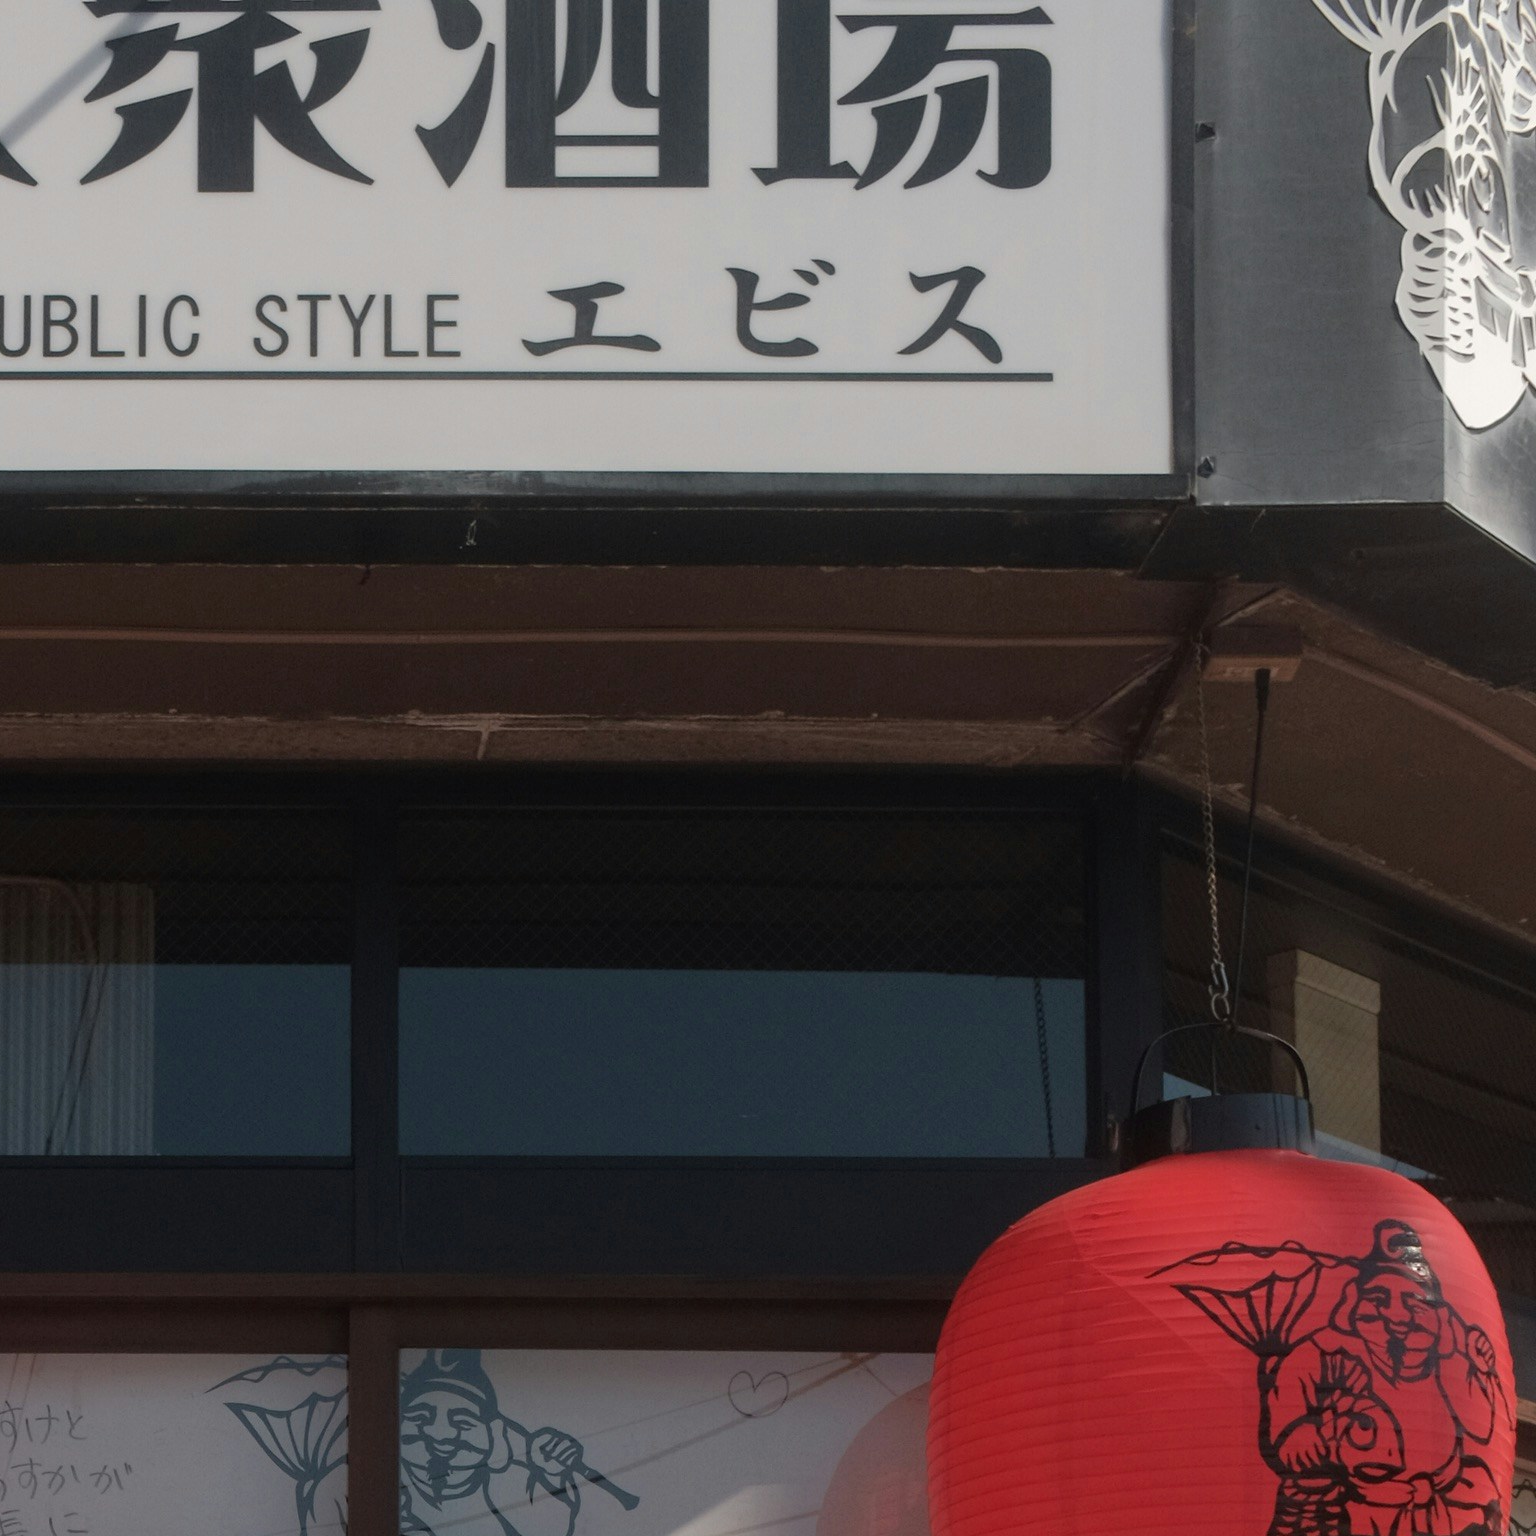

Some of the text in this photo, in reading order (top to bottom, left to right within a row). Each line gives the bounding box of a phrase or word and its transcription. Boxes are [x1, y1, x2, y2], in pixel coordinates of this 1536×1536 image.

[252, 293, 462, 358] STYLE
[521, 258, 1004, 365] エビス
